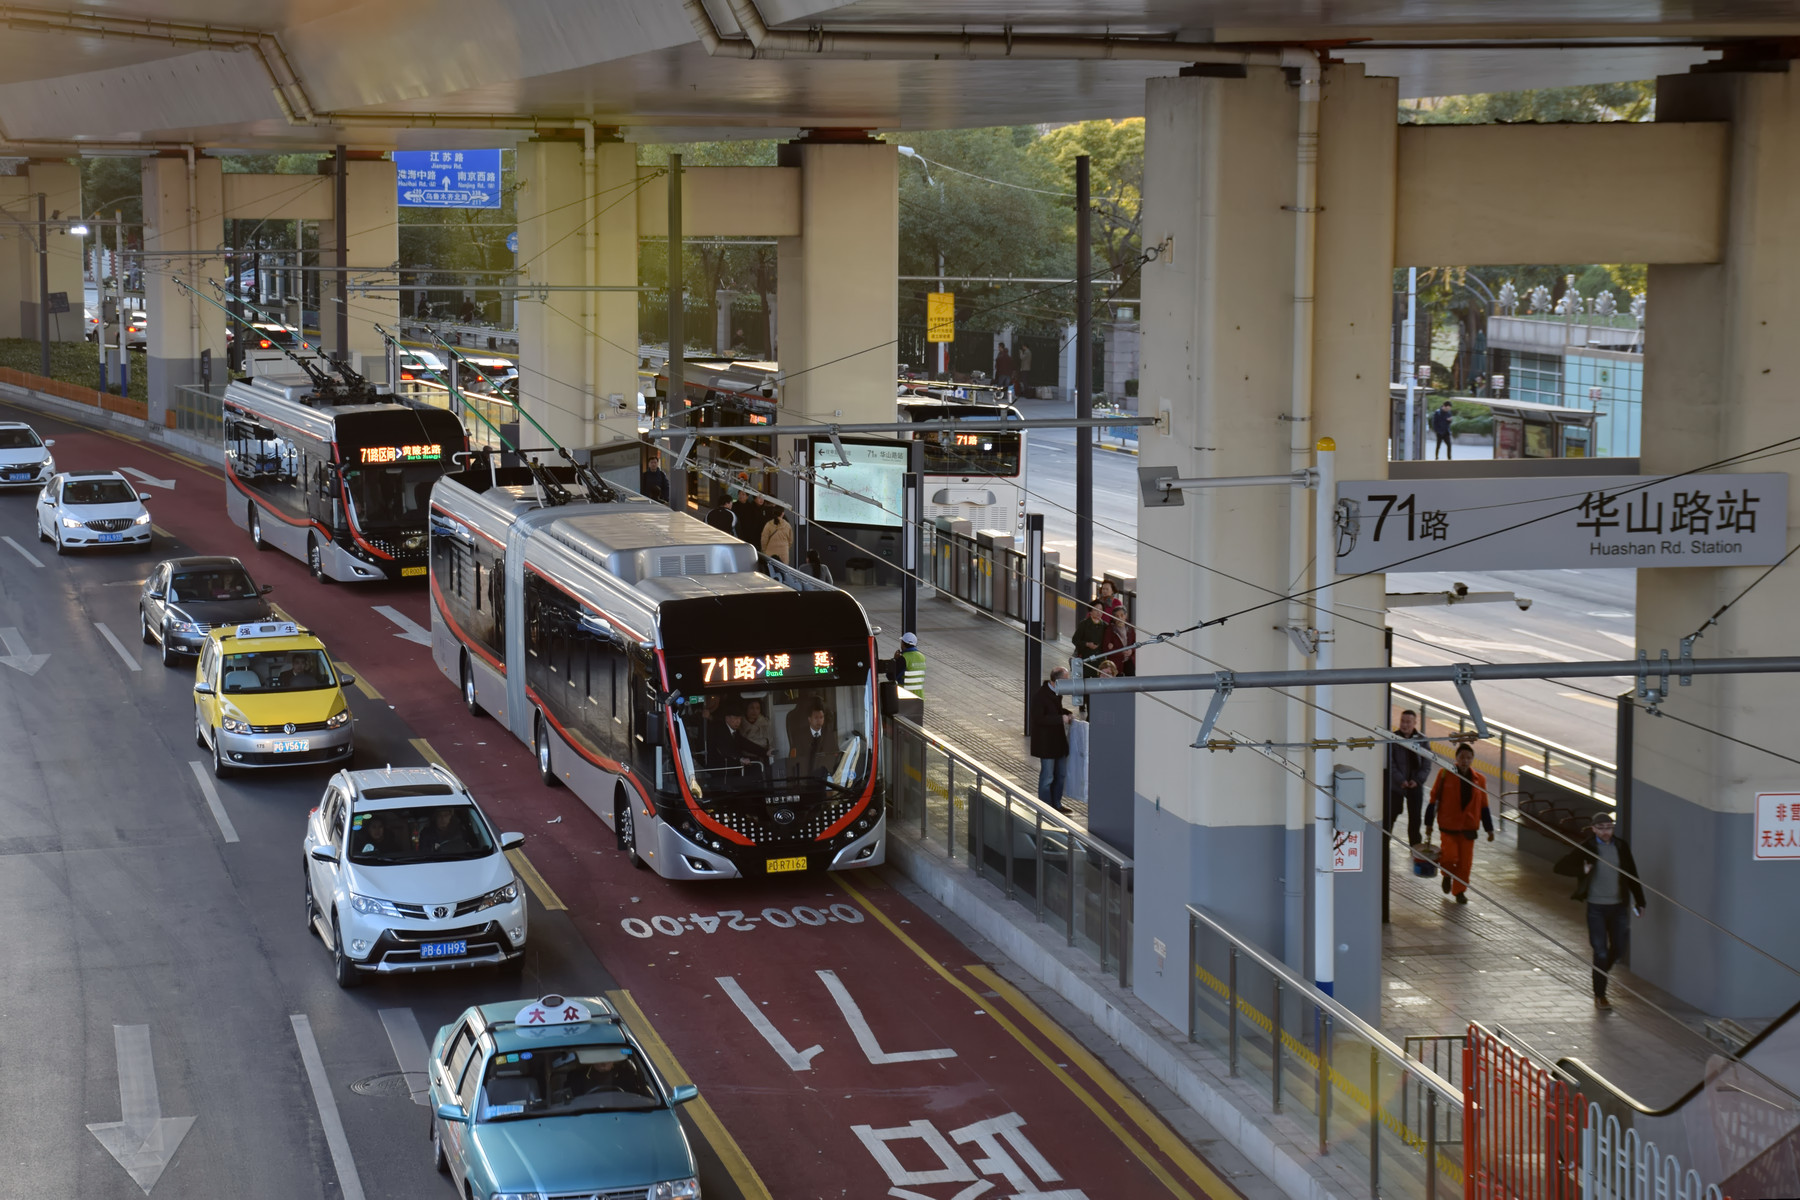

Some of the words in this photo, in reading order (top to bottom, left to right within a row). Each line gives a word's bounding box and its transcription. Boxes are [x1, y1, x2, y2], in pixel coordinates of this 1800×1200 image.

[430, 151, 464, 163] 江苏路
[457, 171, 496, 182] 南京西路
[425, 193, 468, 201] 乌鲁木齐北路
[956, 434, 978, 446] 71路
[360, 446, 396, 463] 71路区间
[1367, 493, 1450, 542] 71路
[1576, 489, 1761, 537] 华山路站
[1589, 542, 1656, 556] Huashan
[1660, 541, 1686, 555] Rd.
[1690, 540, 1743, 554] Station
[240, 625, 296, 636] 强生
[701, 655, 757, 683] 71路
[765, 669, 784, 677] Bund
[1761, 829, 1800, 848] 无关人
[620, 903, 865, 939] 0:00-24:00
[528, 1005, 580, 1024] 大众
[714, 969, 958, 1072] 71
